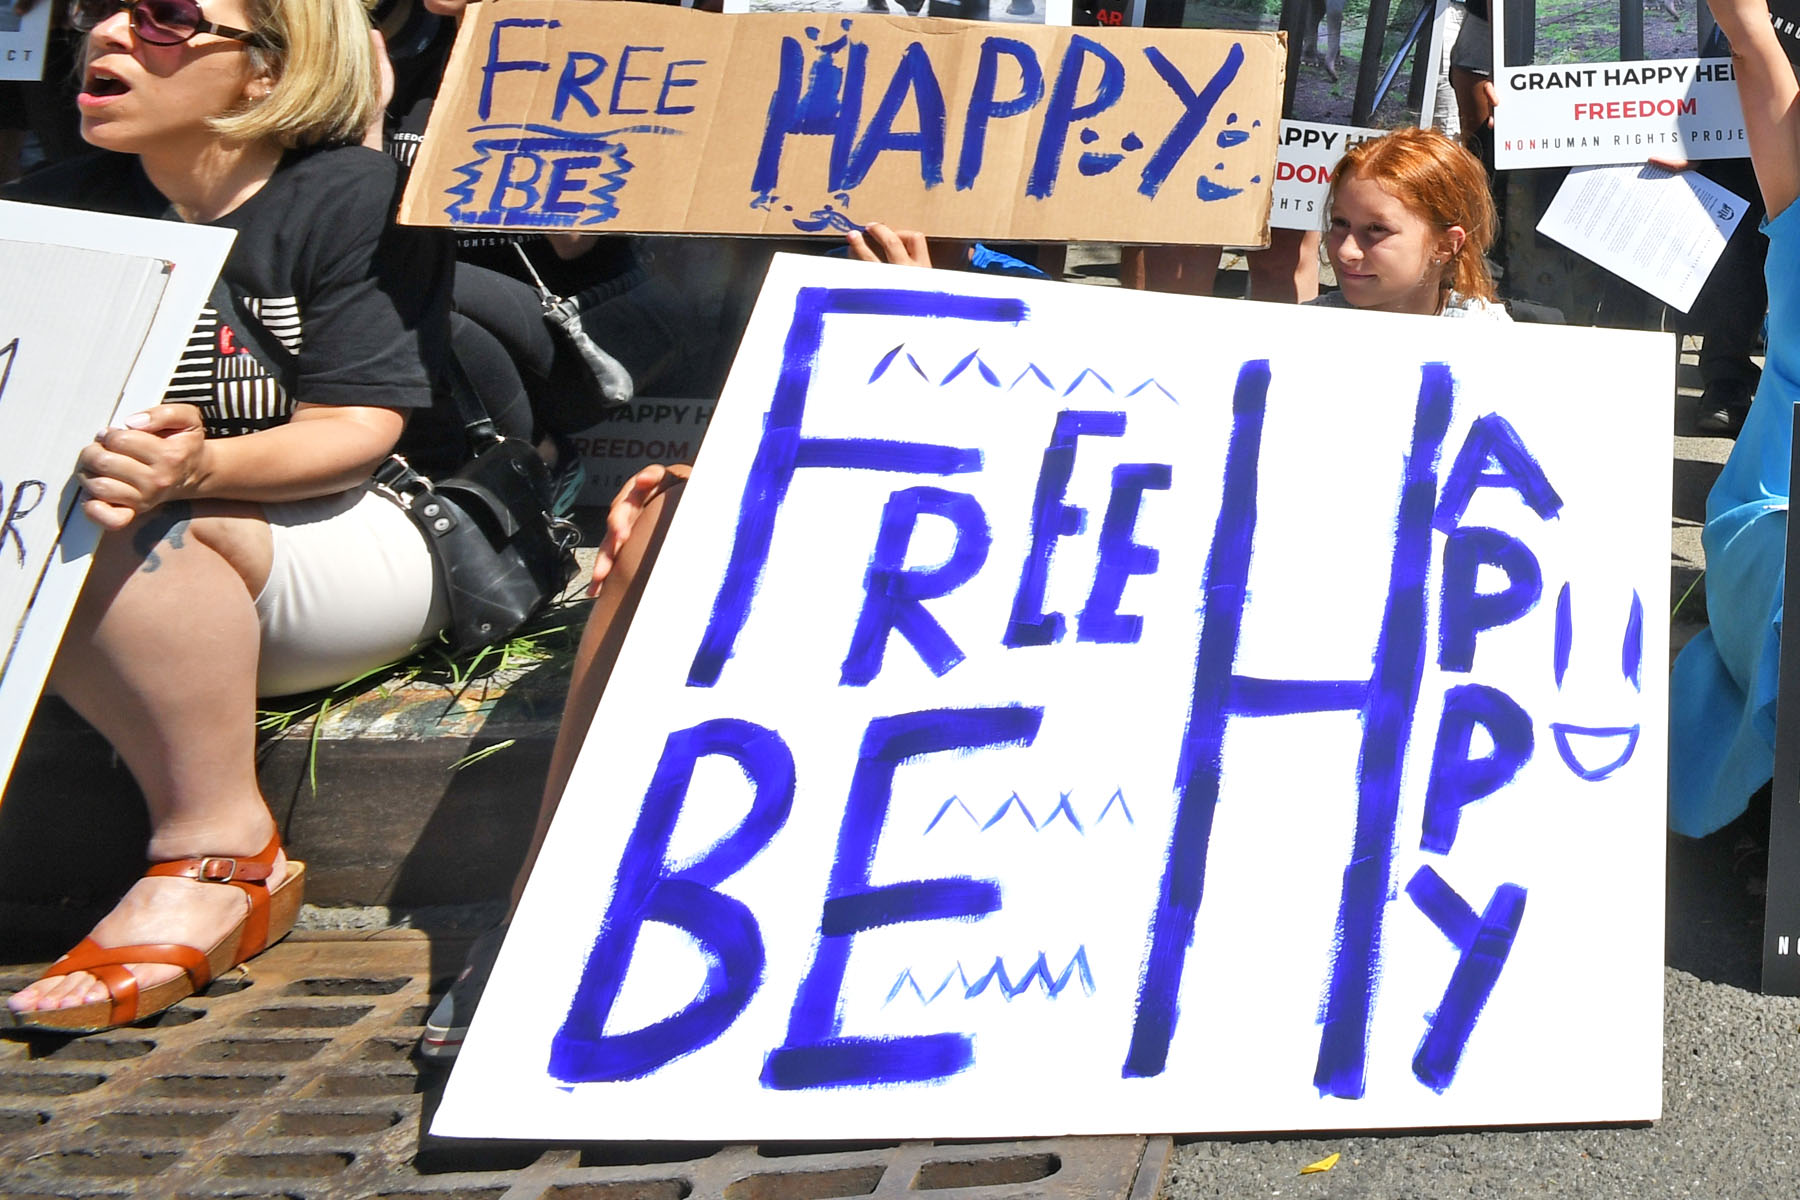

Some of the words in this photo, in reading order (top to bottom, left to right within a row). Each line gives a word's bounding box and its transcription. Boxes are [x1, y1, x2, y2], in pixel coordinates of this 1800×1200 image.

[478, 18, 707, 120] FREE
[1509, 69, 1598, 91] GRANT
[1603, 67, 1690, 89] HAPPY
[750, 34, 1245, 199] HAPPY
[1574, 98, 1697, 121] FREEDOM
[1278, 127, 1338, 150] PPY
[1504, 135, 1600, 152] NONHUMAN
[1614, 131, 1678, 146] RIGHTS
[1691, 128, 1745, 143] PROJE
[489, 151, 602, 213] BE
[458, 238, 495, 248] IGHTS
[612, 404, 690, 425] APPY
[572, 438, 690, 459] REEDOM
[686, 287, 1173, 687] FREE
[1122, 357, 1564, 1100] HAPPY
[547, 705, 1044, 1091] BE
